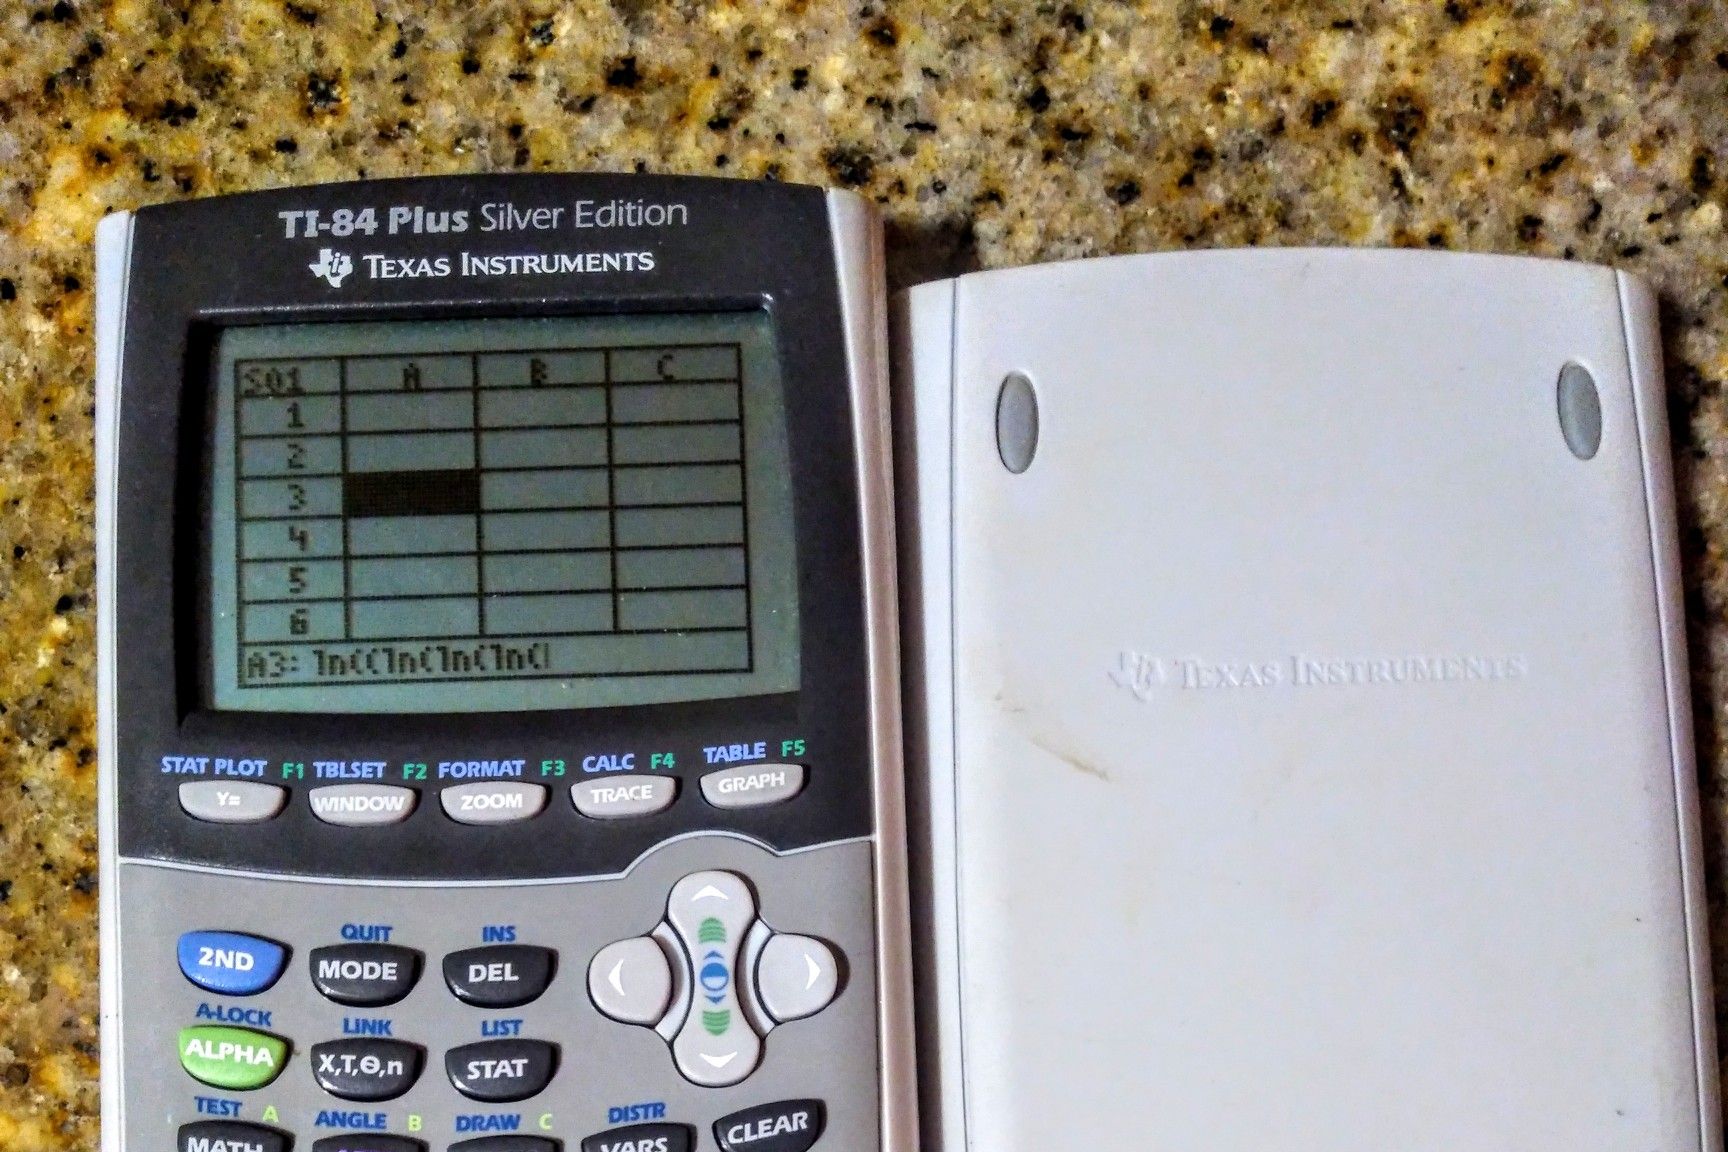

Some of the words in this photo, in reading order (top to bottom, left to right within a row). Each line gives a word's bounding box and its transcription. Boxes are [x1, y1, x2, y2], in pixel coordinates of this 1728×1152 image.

[279, 209, 379, 238] TI-84
[389, 206, 468, 234] Plus
[481, 203, 563, 232] Silver
[575, 199, 688, 228] Edition
[404, 363, 421, 390] A
[531, 358, 547, 387] B
[657, 354, 674, 380] C
[287, 402, 304, 428] 1
[287, 443, 307, 469] 2
[287, 484, 306, 510] 3
[289, 526, 308, 551] 4
[289, 567, 308, 593] 5
[289, 608, 309, 635] 6
[704, 742, 766, 763] TABLE
[782, 740, 806, 757] F5
[161, 756, 209, 775] STAT
[214, 758, 267, 776] PLOT
[282, 762, 305, 779] F1
[313, 761, 386, 778] TBLSET
[438, 760, 526, 778] FORMAT
[541, 760, 565, 776] F3
[583, 753, 635, 773] CALC
[651, 752, 676, 769] F4
[403, 763, 427, 780] F2
[718, 772, 785, 794] GRAPH
[216, 792, 240, 807] Y=
[461, 793, 523, 810] ZOOM
[591, 784, 653, 803] TRACE
[315, 796, 405, 812] WINDOW
[341, 924, 392, 942] QUIT
[483, 925, 516, 942] INS
[198, 947, 254, 971] 2ND
[318, 961, 398, 981] MODE
[468, 964, 518, 983] DEL
[195, 1003, 272, 1026] A-LOCK
[343, 1018, 392, 1035] LINK
[482, 1020, 523, 1037] LIST
[185, 1039, 274, 1067] ALPHA
[467, 1059, 528, 1080] STAT
[195, 1096, 242, 1117] TEST
[263, 1105, 279, 1123] A
[608, 1102, 666, 1124] DISTR
[315, 1110, 388, 1129] ANGLE
[408, 1115, 422, 1132] B
[456, 1114, 521, 1132] DRAW
[539, 1114, 552, 1130] C
[727, 1111, 808, 1144] CLEAR
